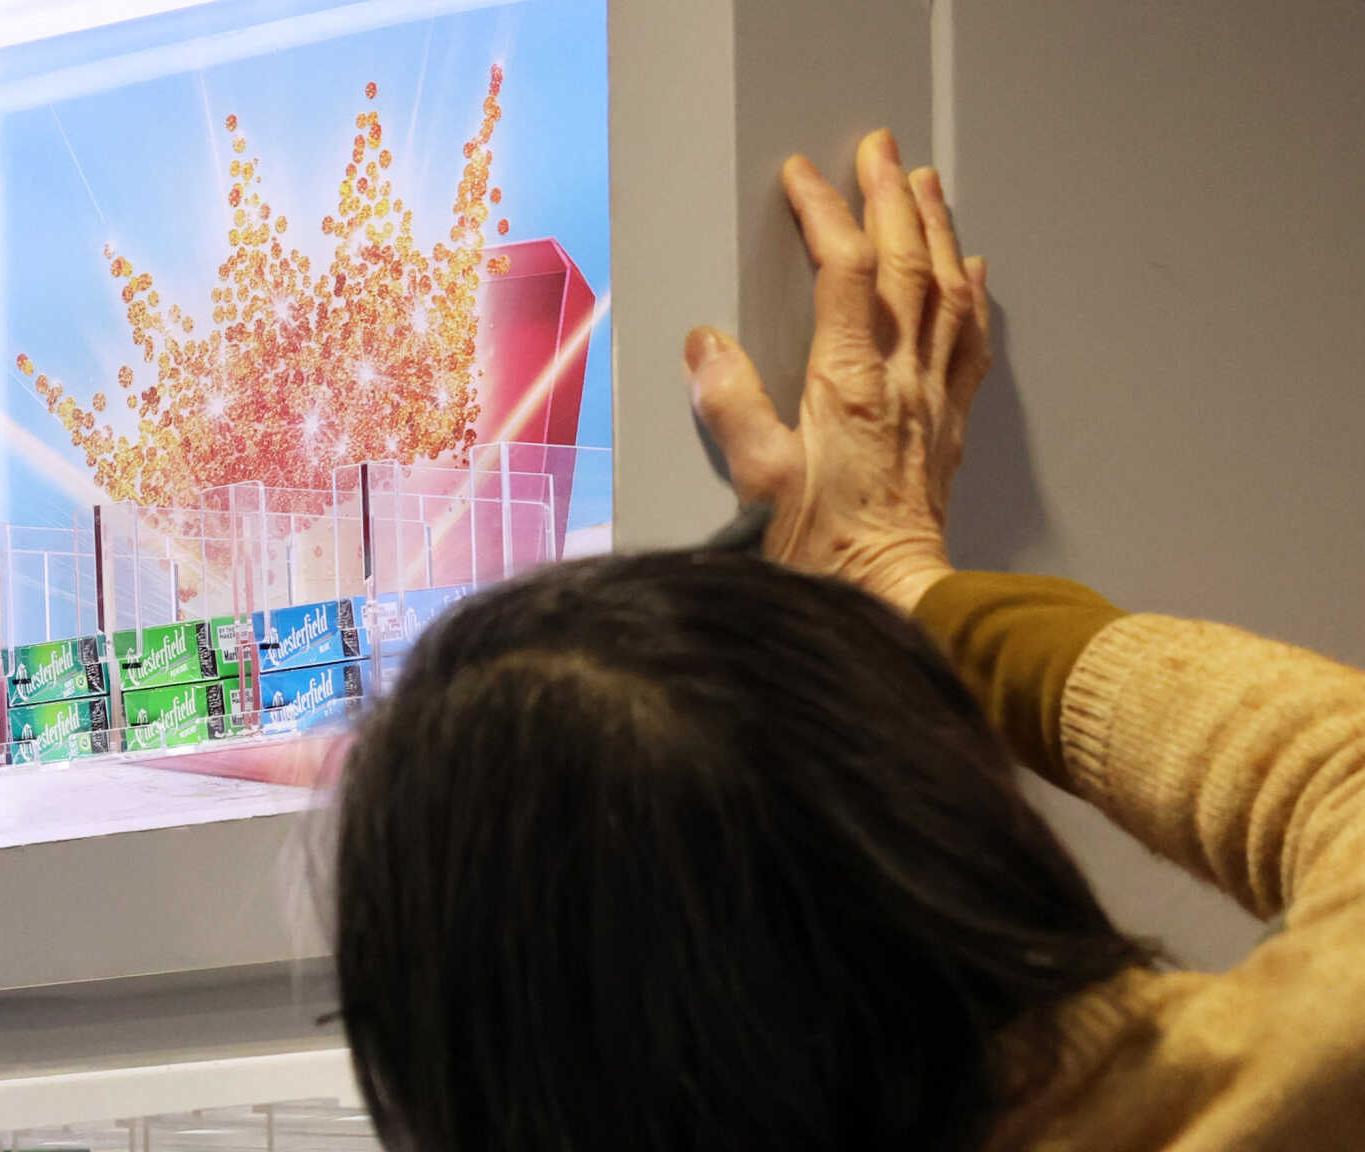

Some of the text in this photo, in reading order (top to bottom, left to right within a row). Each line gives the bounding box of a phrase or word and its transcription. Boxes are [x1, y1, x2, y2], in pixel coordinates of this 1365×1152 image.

[126, 626, 187, 687] Chesterfield
[264, 605, 329, 667] Chesterfield
[15, 641, 74, 702] Chesterfield
[134, 688, 197, 748] Chesterfield
